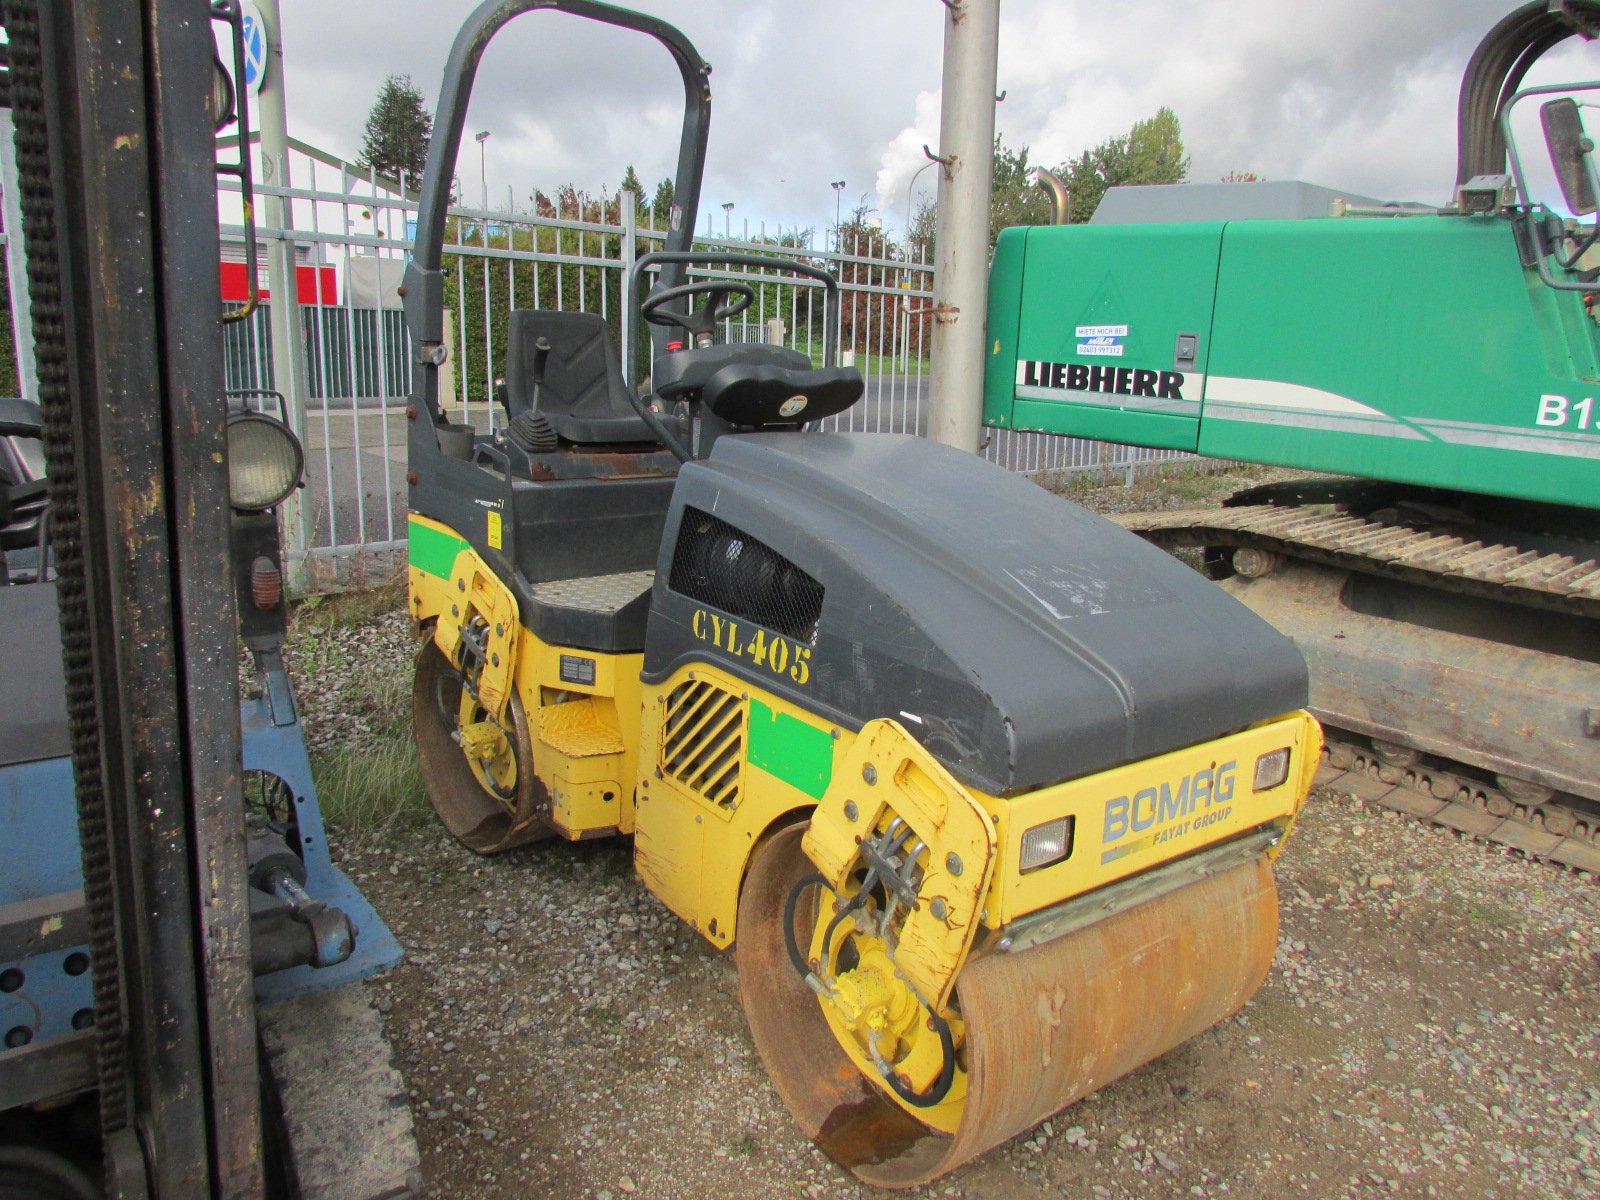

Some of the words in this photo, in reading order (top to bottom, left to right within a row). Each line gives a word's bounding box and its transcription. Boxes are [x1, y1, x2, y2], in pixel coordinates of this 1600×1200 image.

[1078, 328, 1096, 336] MIETE
[1024, 361, 1184, 400] LIEBHERR
[1535, 394, 1600, 431] B1
[1103, 760, 1236, 844] BOMAG
[1152, 821, 1190, 845] FAYAT
[1193, 806, 1232, 830] GROUP
